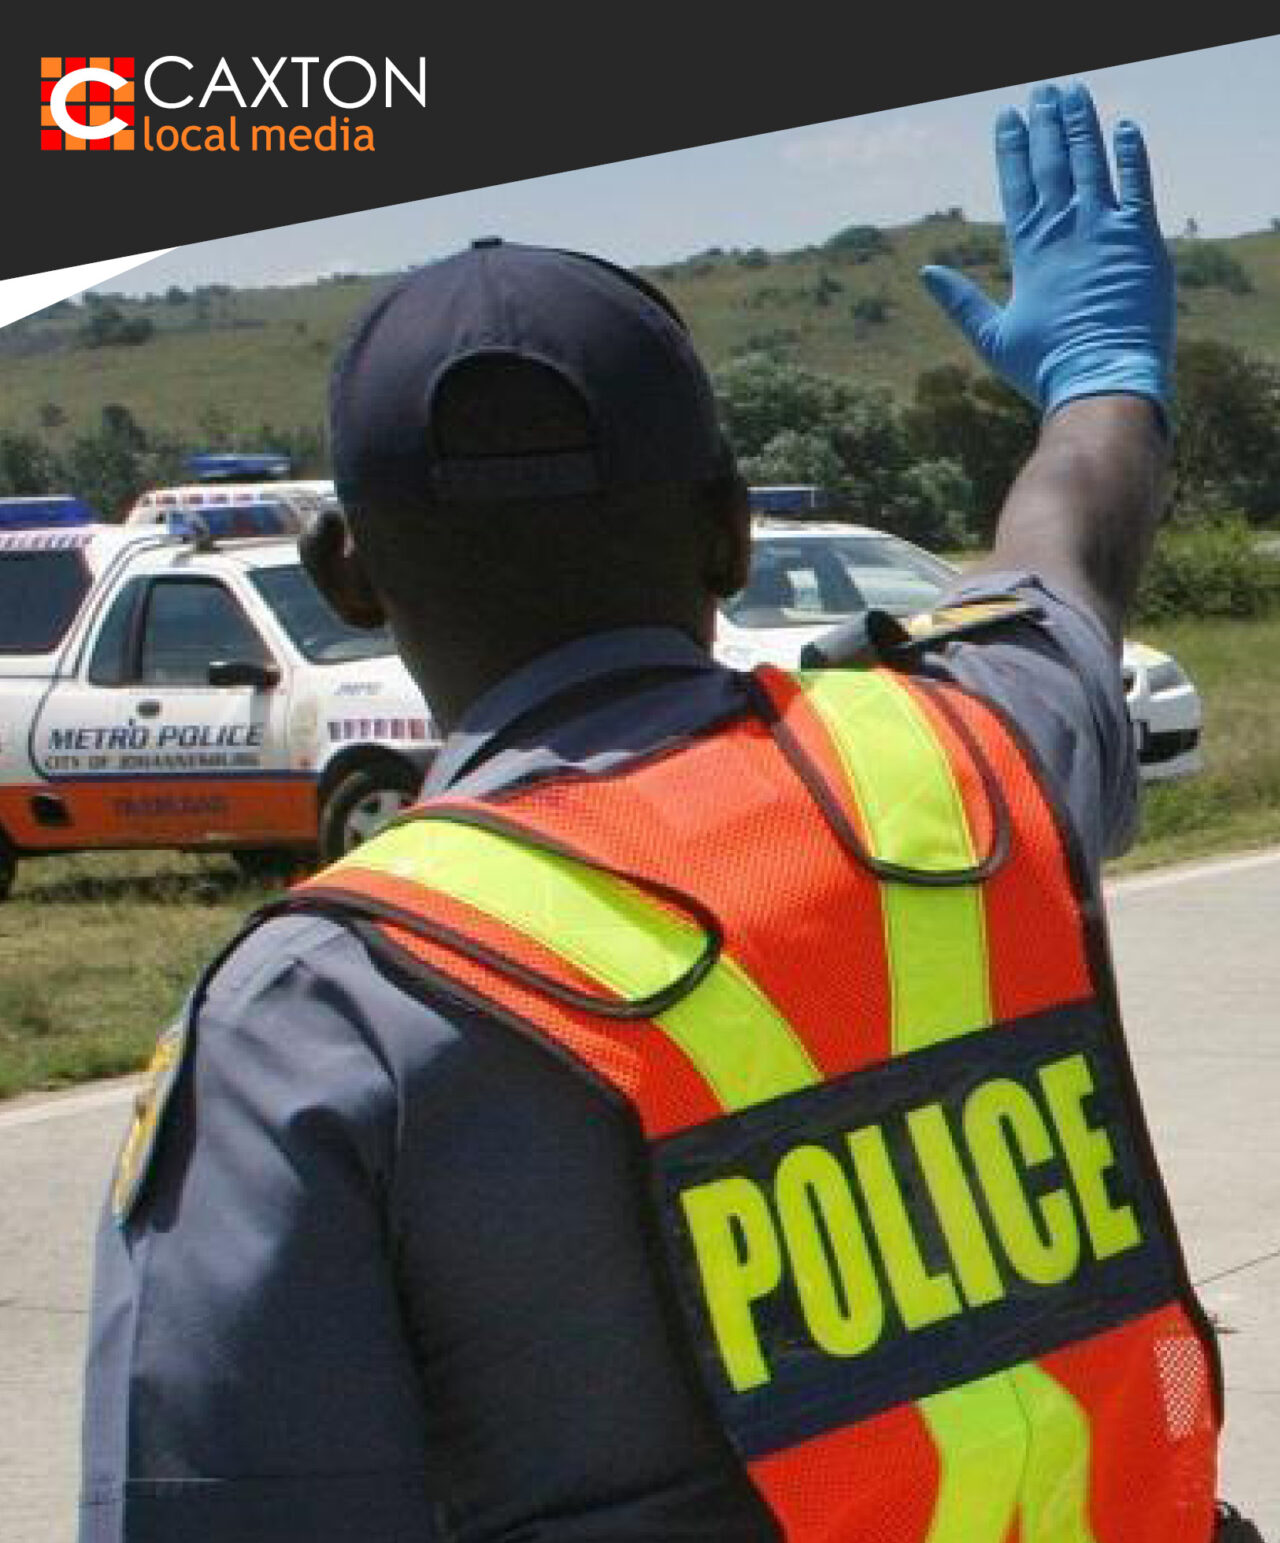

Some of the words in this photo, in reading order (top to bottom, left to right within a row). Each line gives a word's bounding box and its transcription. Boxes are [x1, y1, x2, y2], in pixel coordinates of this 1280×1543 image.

[50, 728, 149, 749] METRO
[158, 725, 264, 747] POLICE
[681, 1054, 1143, 1393] POLICE
